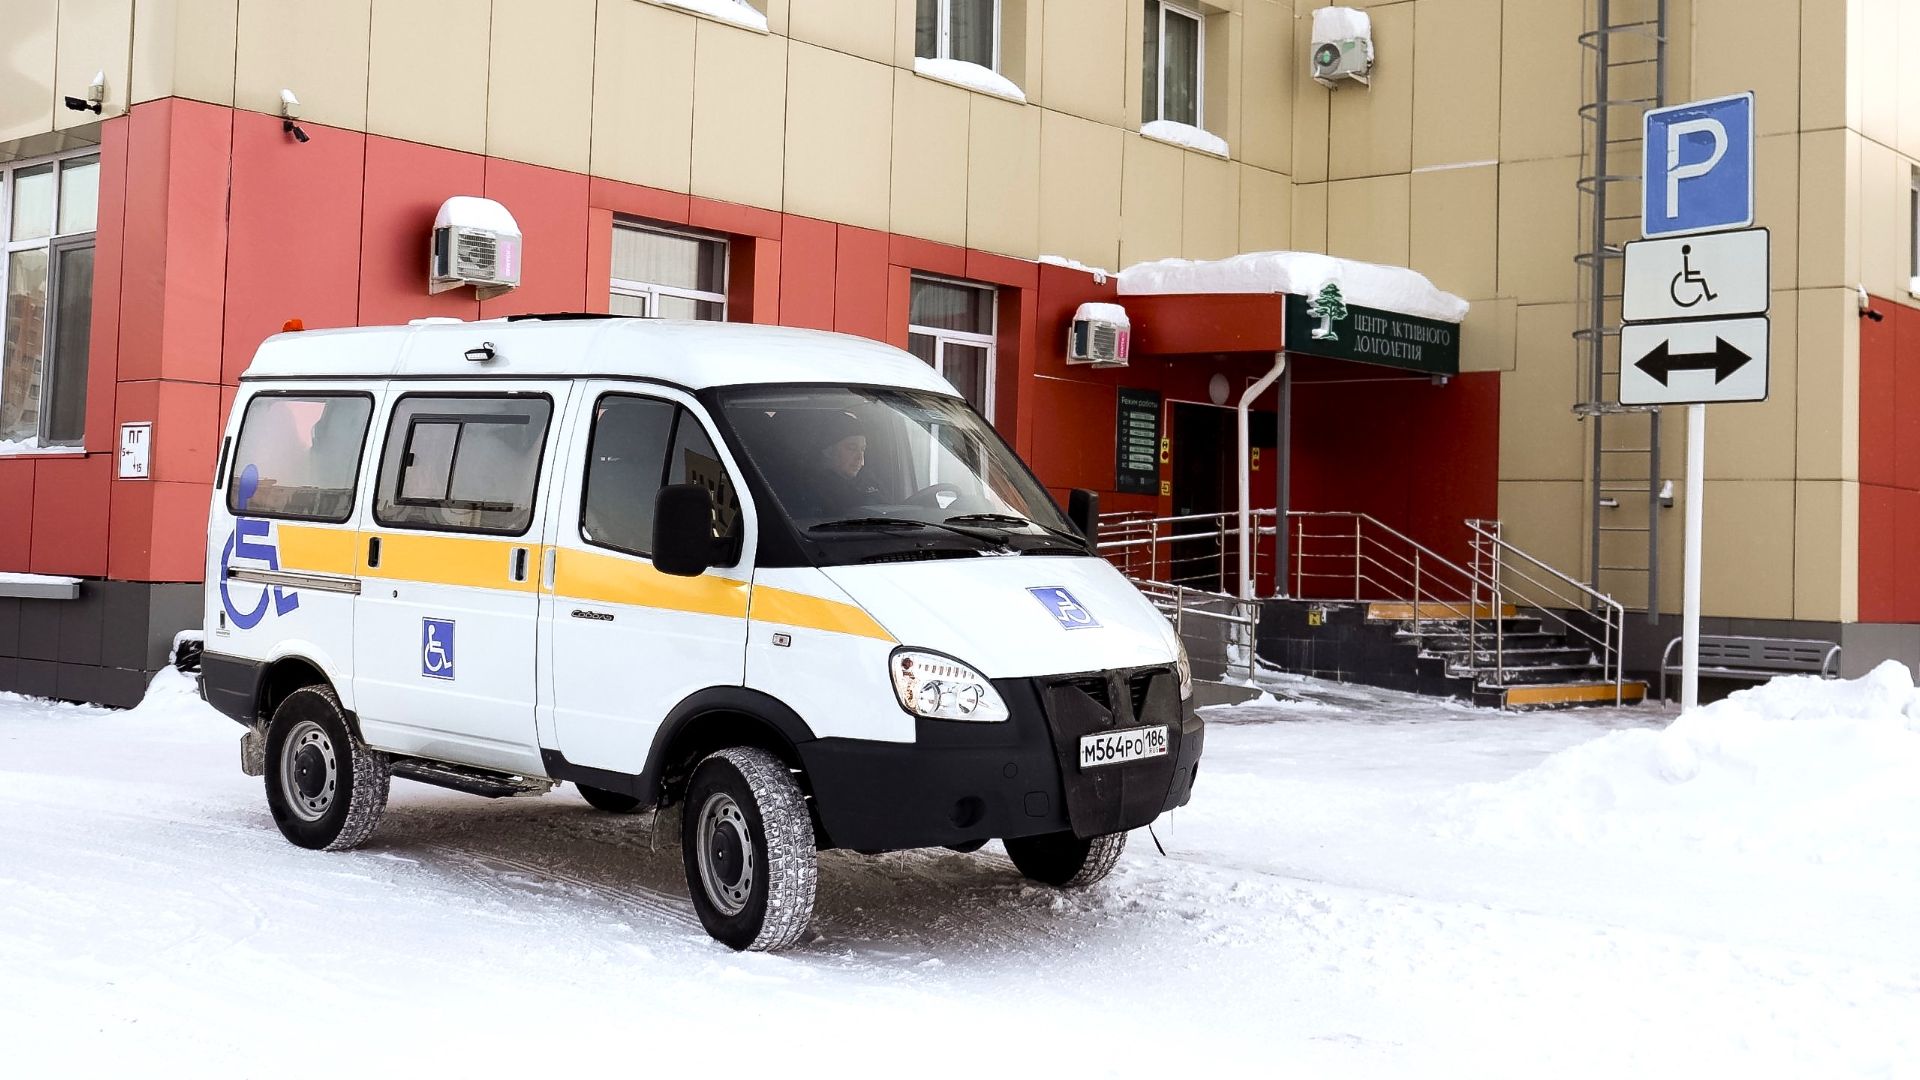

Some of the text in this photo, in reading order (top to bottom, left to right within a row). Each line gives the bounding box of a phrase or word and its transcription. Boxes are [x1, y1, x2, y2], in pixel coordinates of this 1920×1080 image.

[1667, 117, 1728, 219] P
[1354, 314, 1450, 346] ЦЕНТР АКТИВНОГО
[1354, 335, 1422, 361] ДОЛГОЛЕТИЯ
[128, 430, 143, 444] ПГ
[1145, 729, 1164, 747] 186
